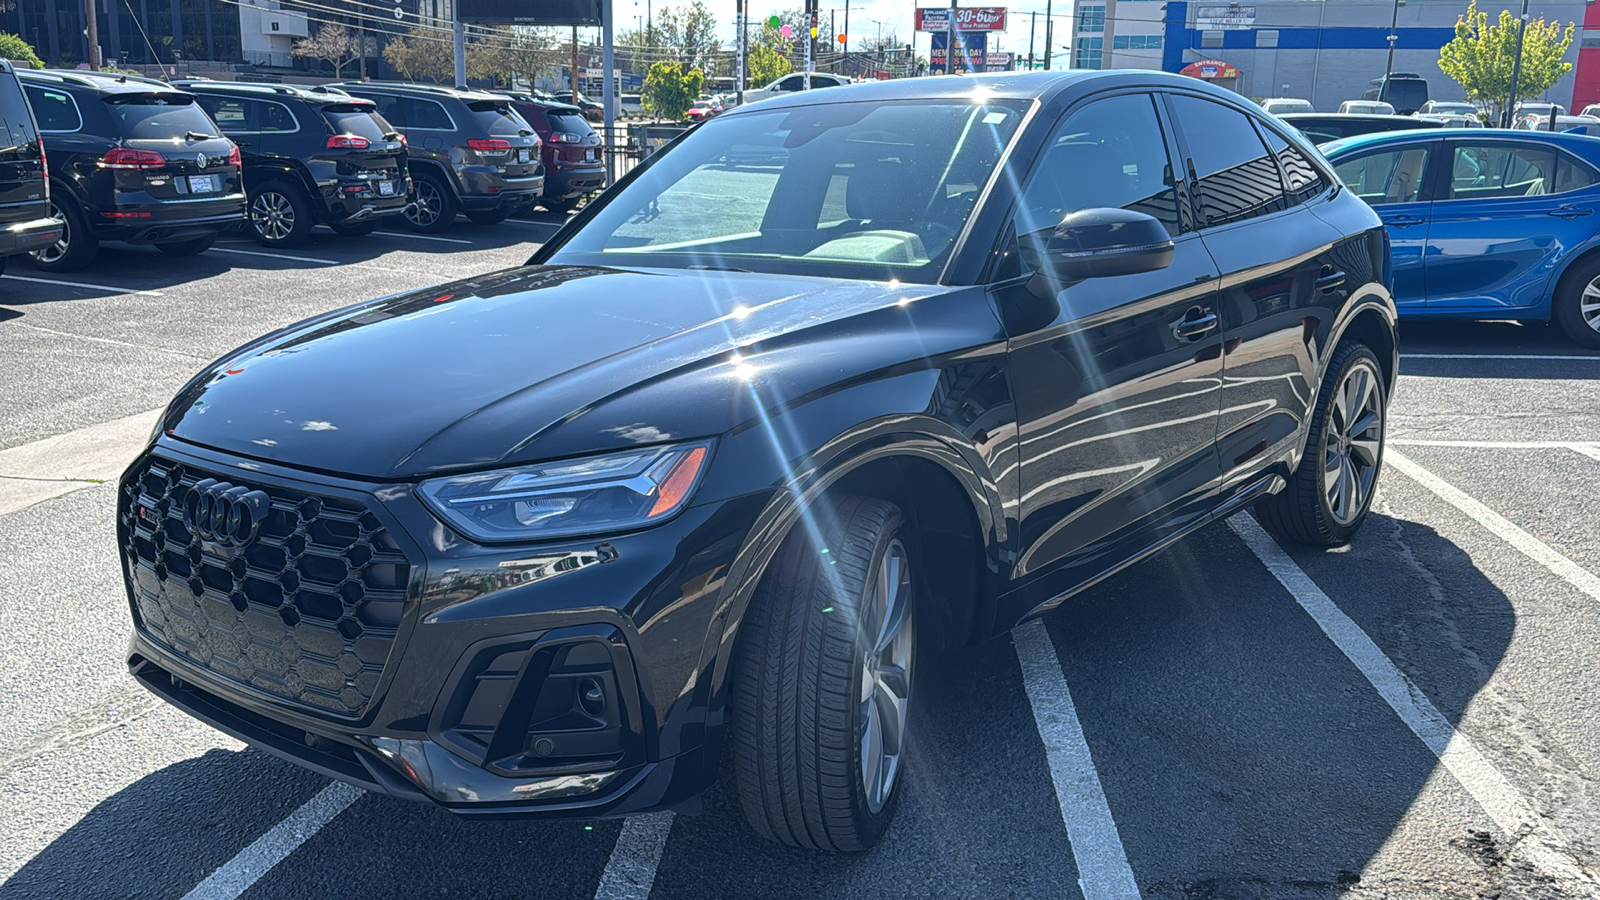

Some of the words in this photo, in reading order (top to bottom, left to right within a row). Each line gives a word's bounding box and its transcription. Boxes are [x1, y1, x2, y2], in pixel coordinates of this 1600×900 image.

[932, 48, 967, 57] MEMRIAL
[969, 48, 983, 56] DAY
[931, 57, 960, 65] PRICS
[961, 57, 983, 65] NOW!
